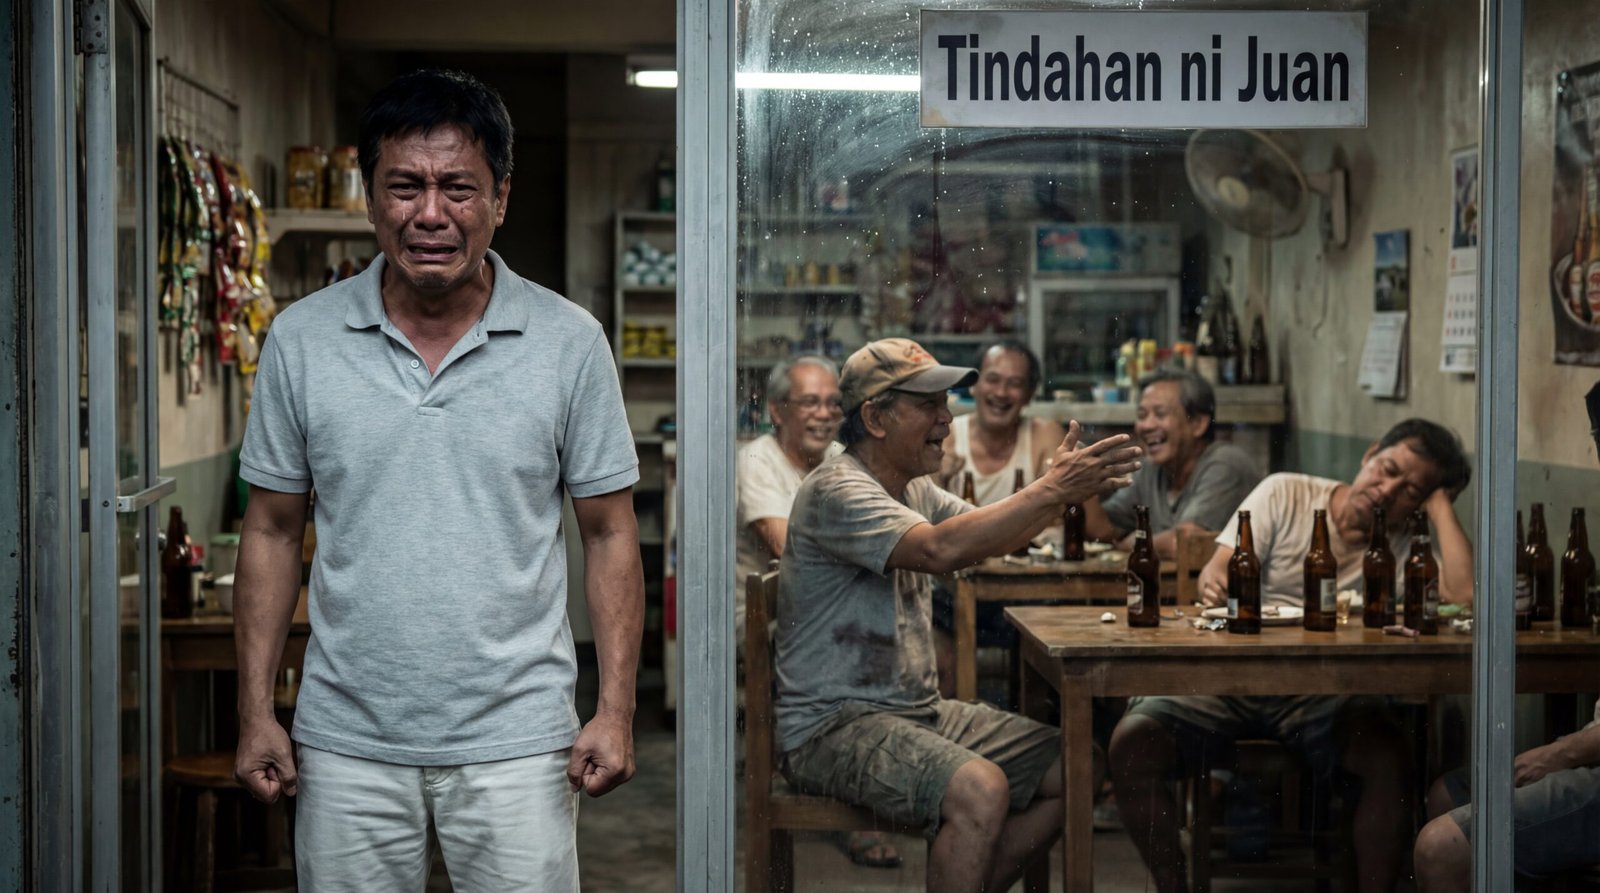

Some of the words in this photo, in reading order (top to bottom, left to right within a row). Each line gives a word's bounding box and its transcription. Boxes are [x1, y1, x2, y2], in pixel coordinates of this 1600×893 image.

[938, 34, 1161, 101] Tindahan
[1182, 34, 1221, 101] ni
[1238, 35, 1349, 102] Juan
